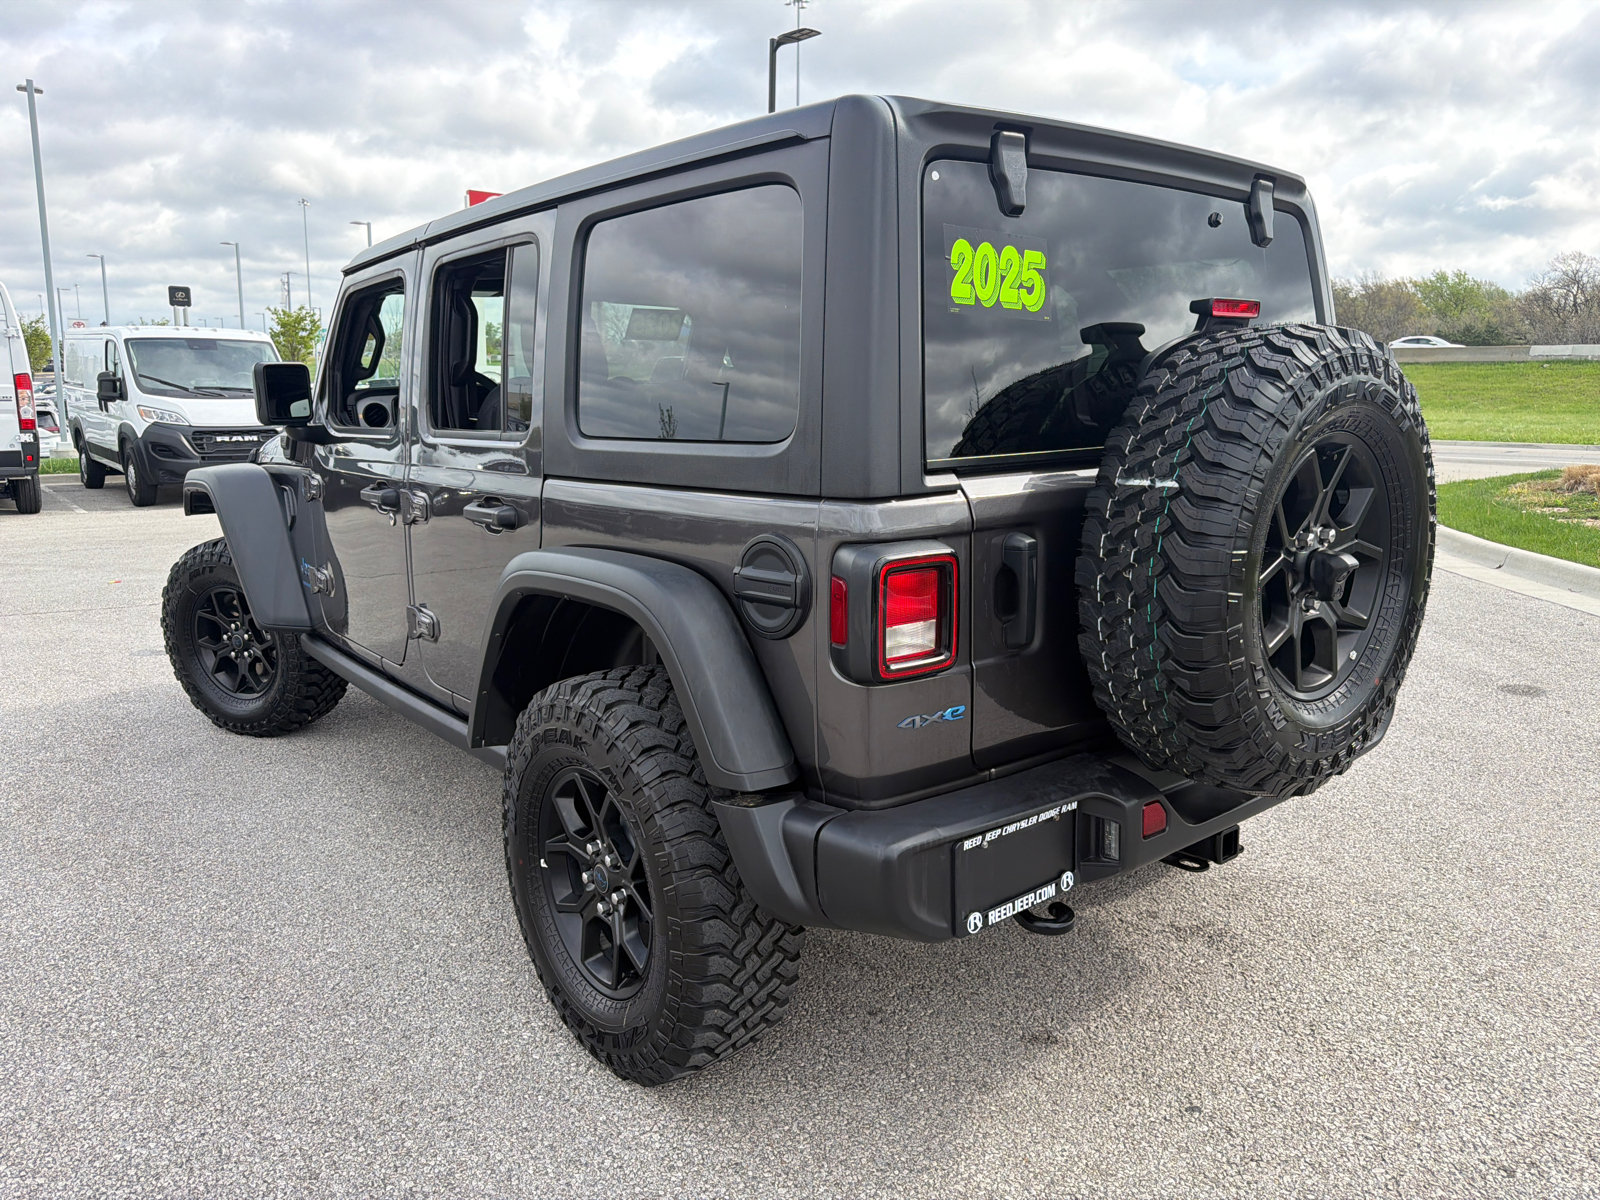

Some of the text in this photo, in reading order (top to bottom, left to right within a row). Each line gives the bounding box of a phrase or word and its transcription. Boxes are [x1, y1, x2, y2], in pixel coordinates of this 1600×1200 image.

[950, 238, 1047, 312] 2025
[767, 585, 787, 594] FUEL
[897, 704, 966, 730] 4xe
[963, 800, 1079, 851] REED JEEP CHRYSLER DODGE RAM
[988, 882, 1057, 926] REEDJEEP.COM
